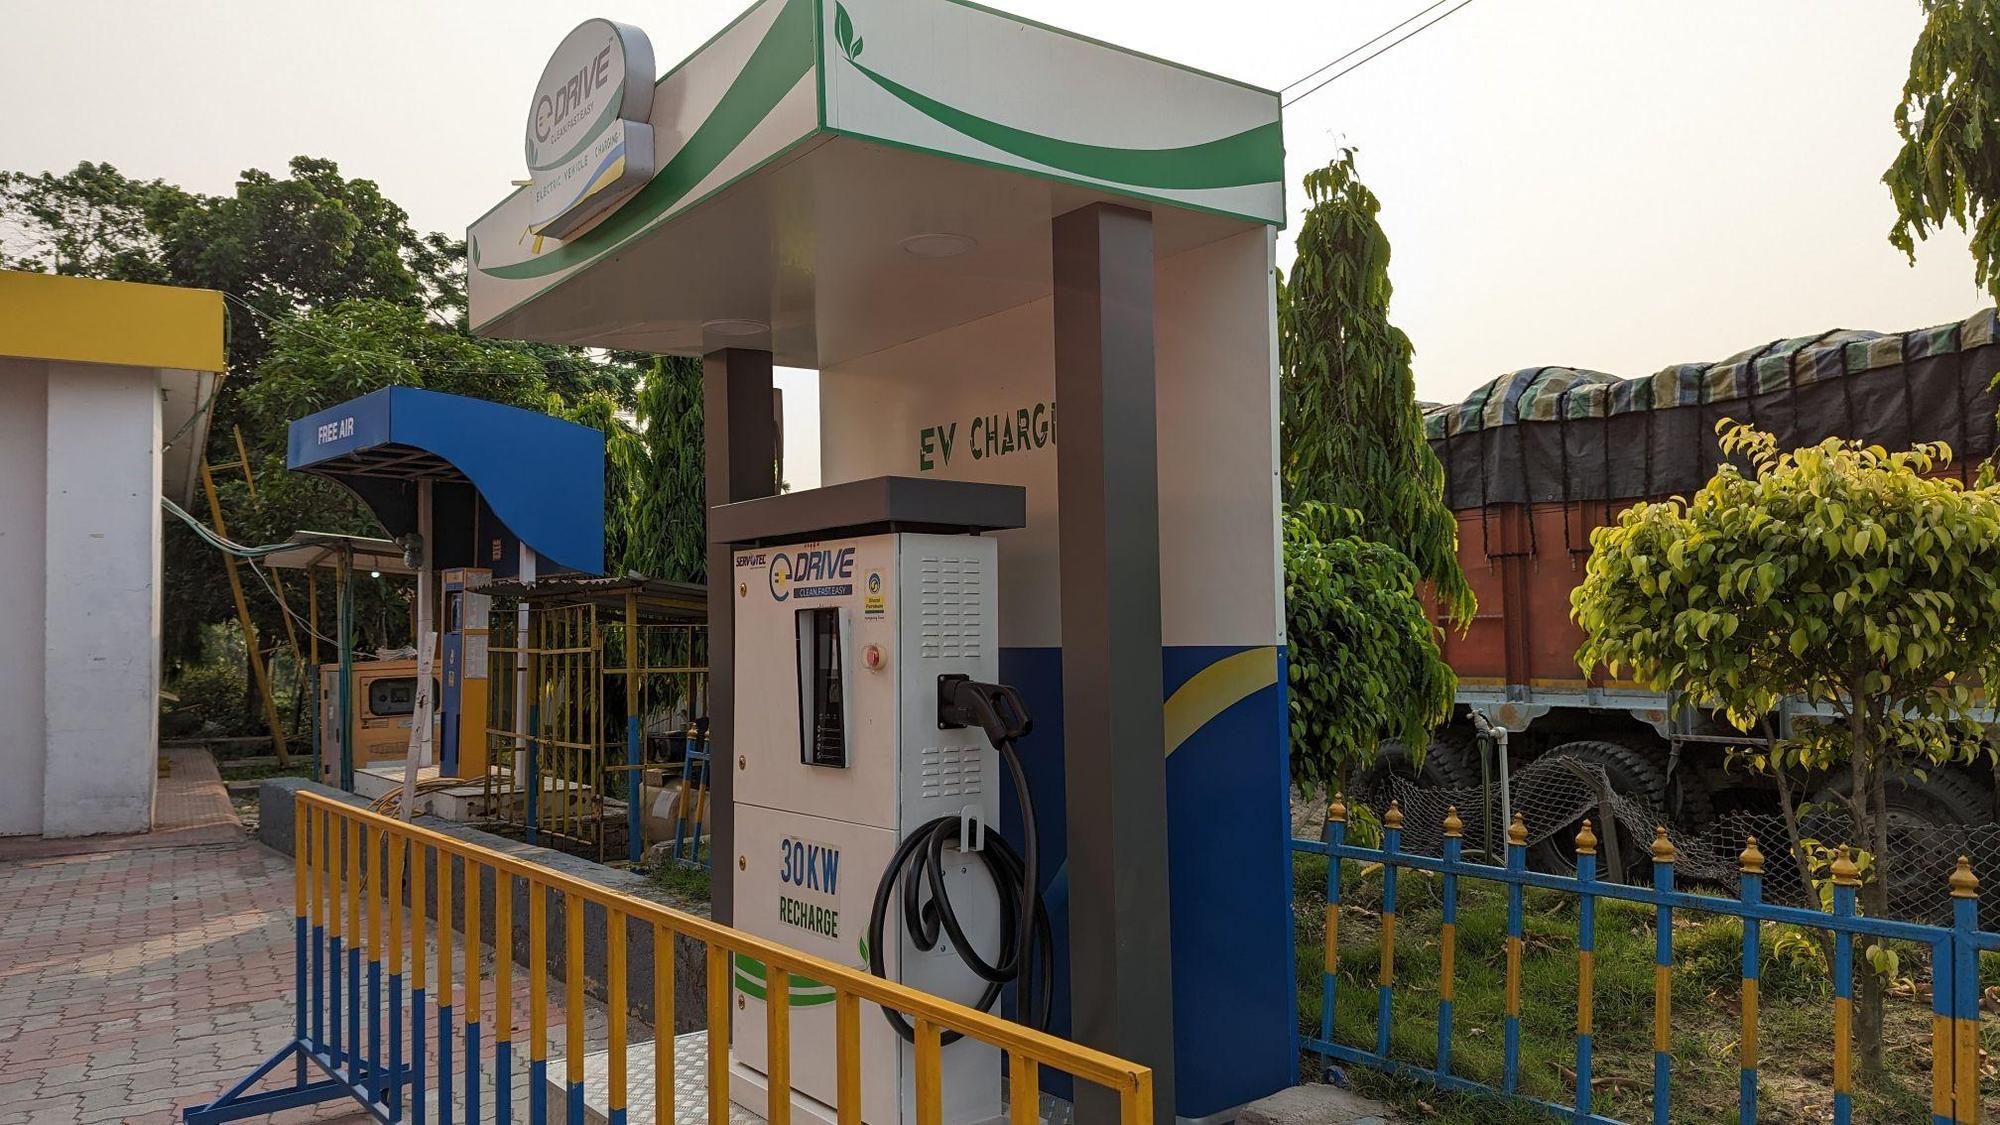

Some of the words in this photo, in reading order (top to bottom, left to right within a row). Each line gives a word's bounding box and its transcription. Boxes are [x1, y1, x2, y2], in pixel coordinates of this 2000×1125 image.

[536, 174, 562, 203] ELECTRIC
[563, 154, 589, 182] VEHICLE
[318, 421, 338, 445] FREE
[339, 416, 354, 439] AIR
[920, 422, 957, 472] EV
[780, 896, 838, 939] RECHARGE
